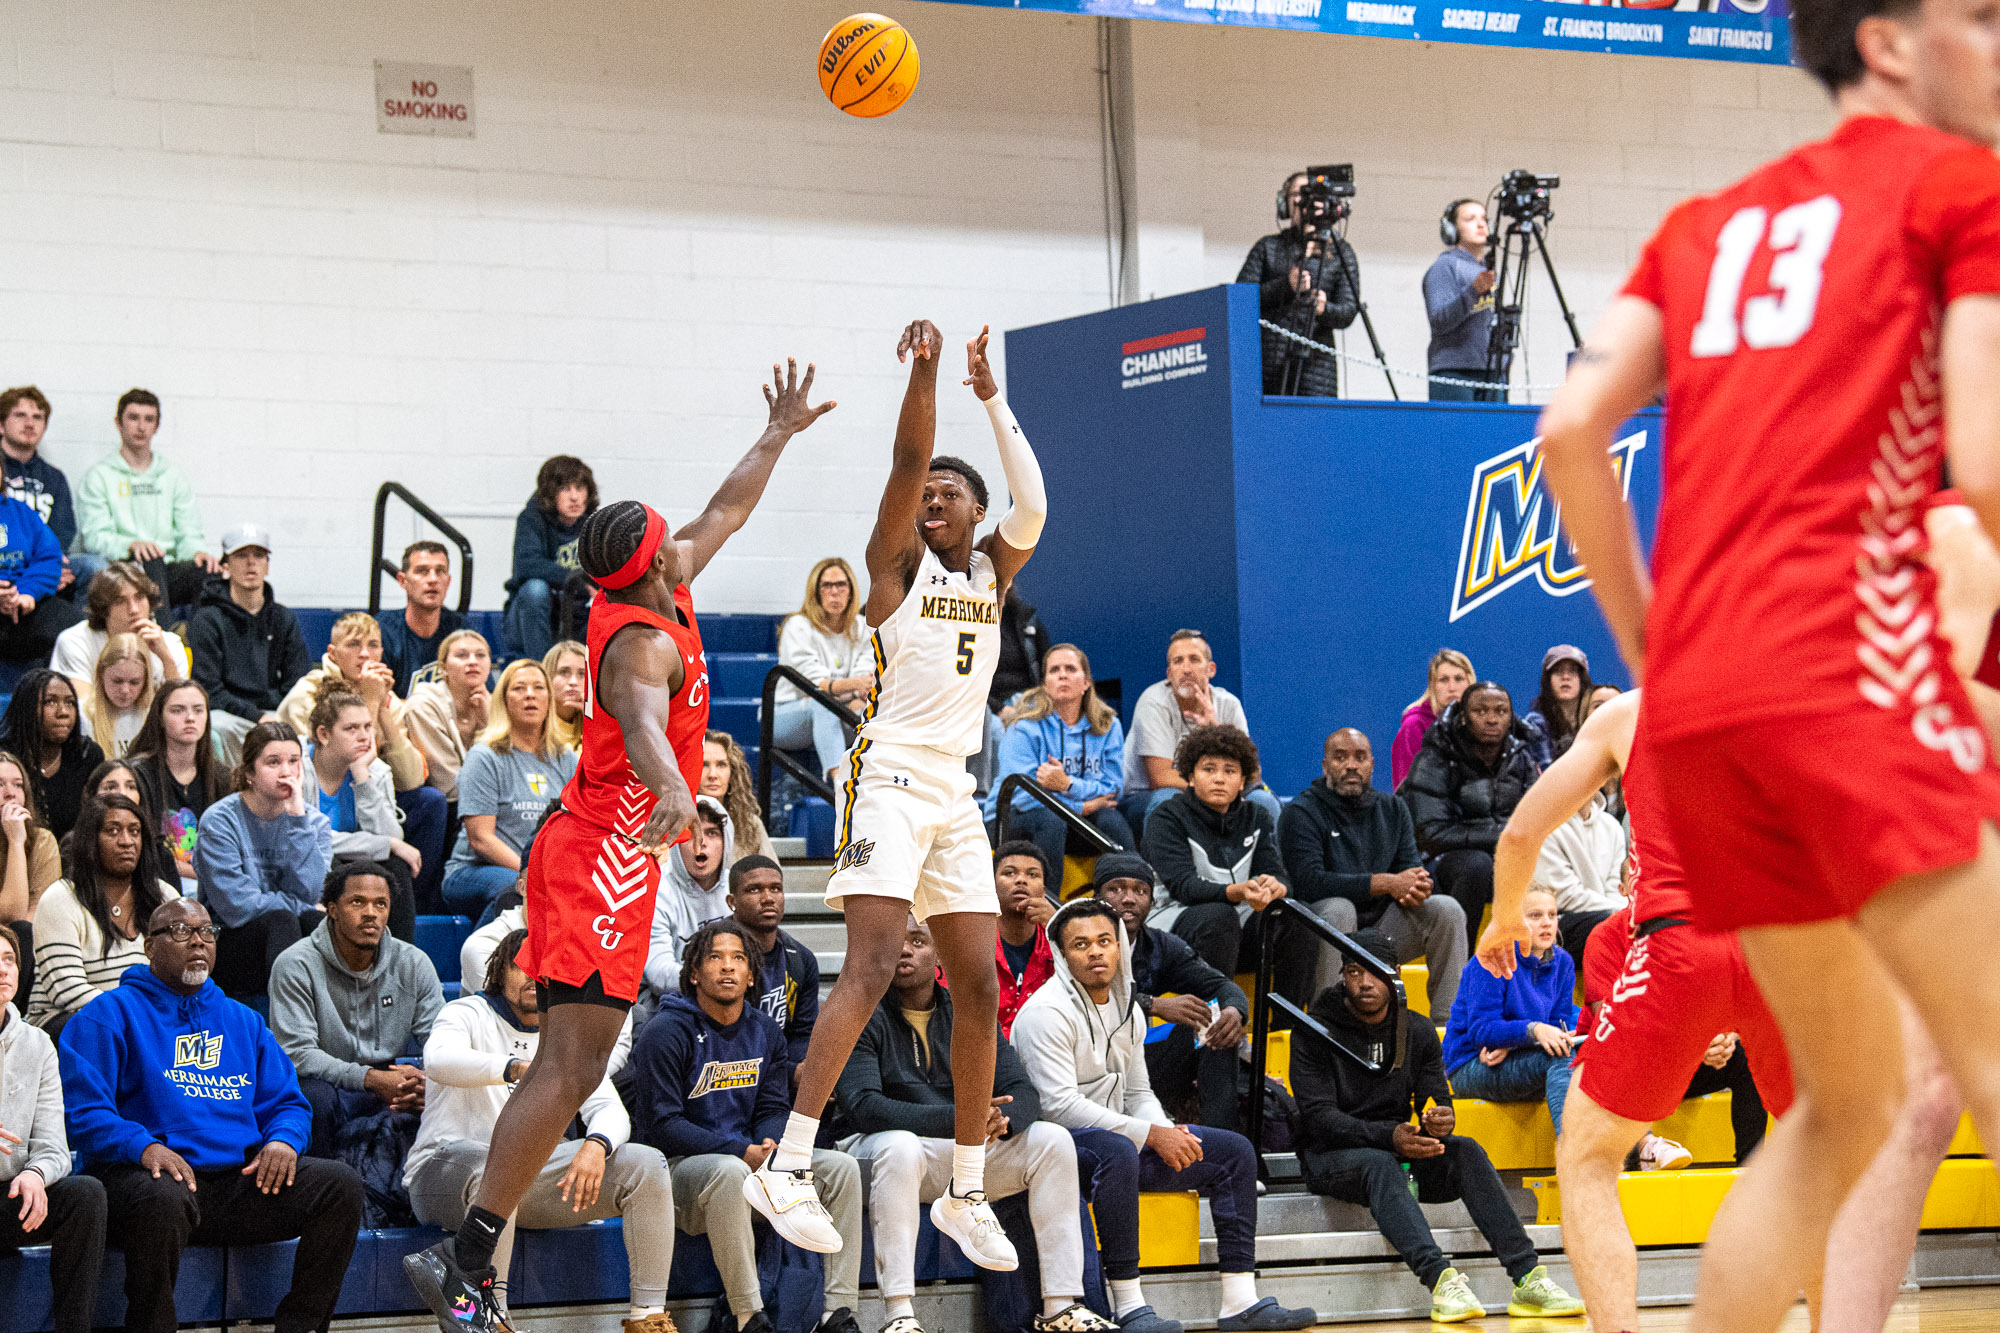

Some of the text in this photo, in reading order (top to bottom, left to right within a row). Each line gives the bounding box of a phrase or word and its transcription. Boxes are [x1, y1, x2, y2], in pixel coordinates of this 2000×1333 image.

[1346, 2, 1416, 26] MERRIMACK
[1442, 8, 1520, 33] SACRED HEART
[1559, 18, 1605, 40] FRANCIS
[1605, 21, 1663, 43] BROOKLYN
[1688, 25, 1772, 51] SAINT FRANCIS U
[822, 22, 876, 74] Wilson
[411, 80, 438, 98] NO
[384, 98, 467, 121] SMOKING
[1690, 193, 1842, 358] 13
[1121, 343, 1208, 377] CHANNEL
[1121, 364, 1207, 390] BUILDING COMPANY
[956, 631, 977, 676] 5
[592, 914, 644, 951] CU
[174, 1030, 224, 1070] MC
[163, 1068, 252, 1089] MERRIMACK
